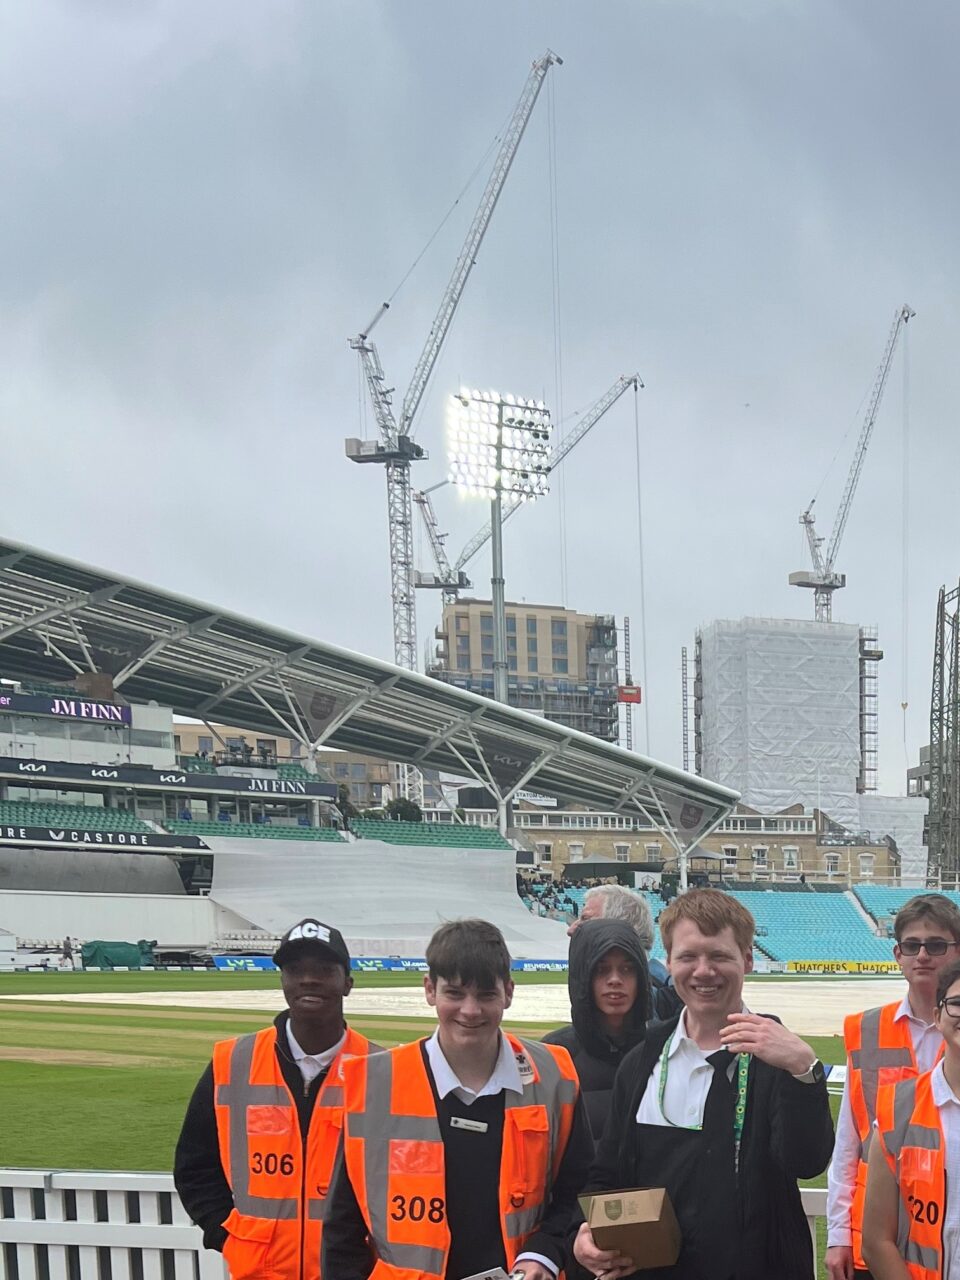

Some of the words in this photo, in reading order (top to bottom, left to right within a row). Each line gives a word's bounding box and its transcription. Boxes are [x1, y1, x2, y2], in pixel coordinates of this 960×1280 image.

[51, 699, 76, 716] JM
[80, 701, 122, 721] FINN
[248, 779, 268, 792] JM
[271, 780, 307, 794] FINN
[71, 831, 148, 845] CASTORE
[288, 922, 331, 943] ACE
[793, 962, 848, 971] THATCHERS
[855, 962, 900, 971] THATCHE
[251, 1152, 294, 1176] 306
[391, 1195, 445, 1223] 308
